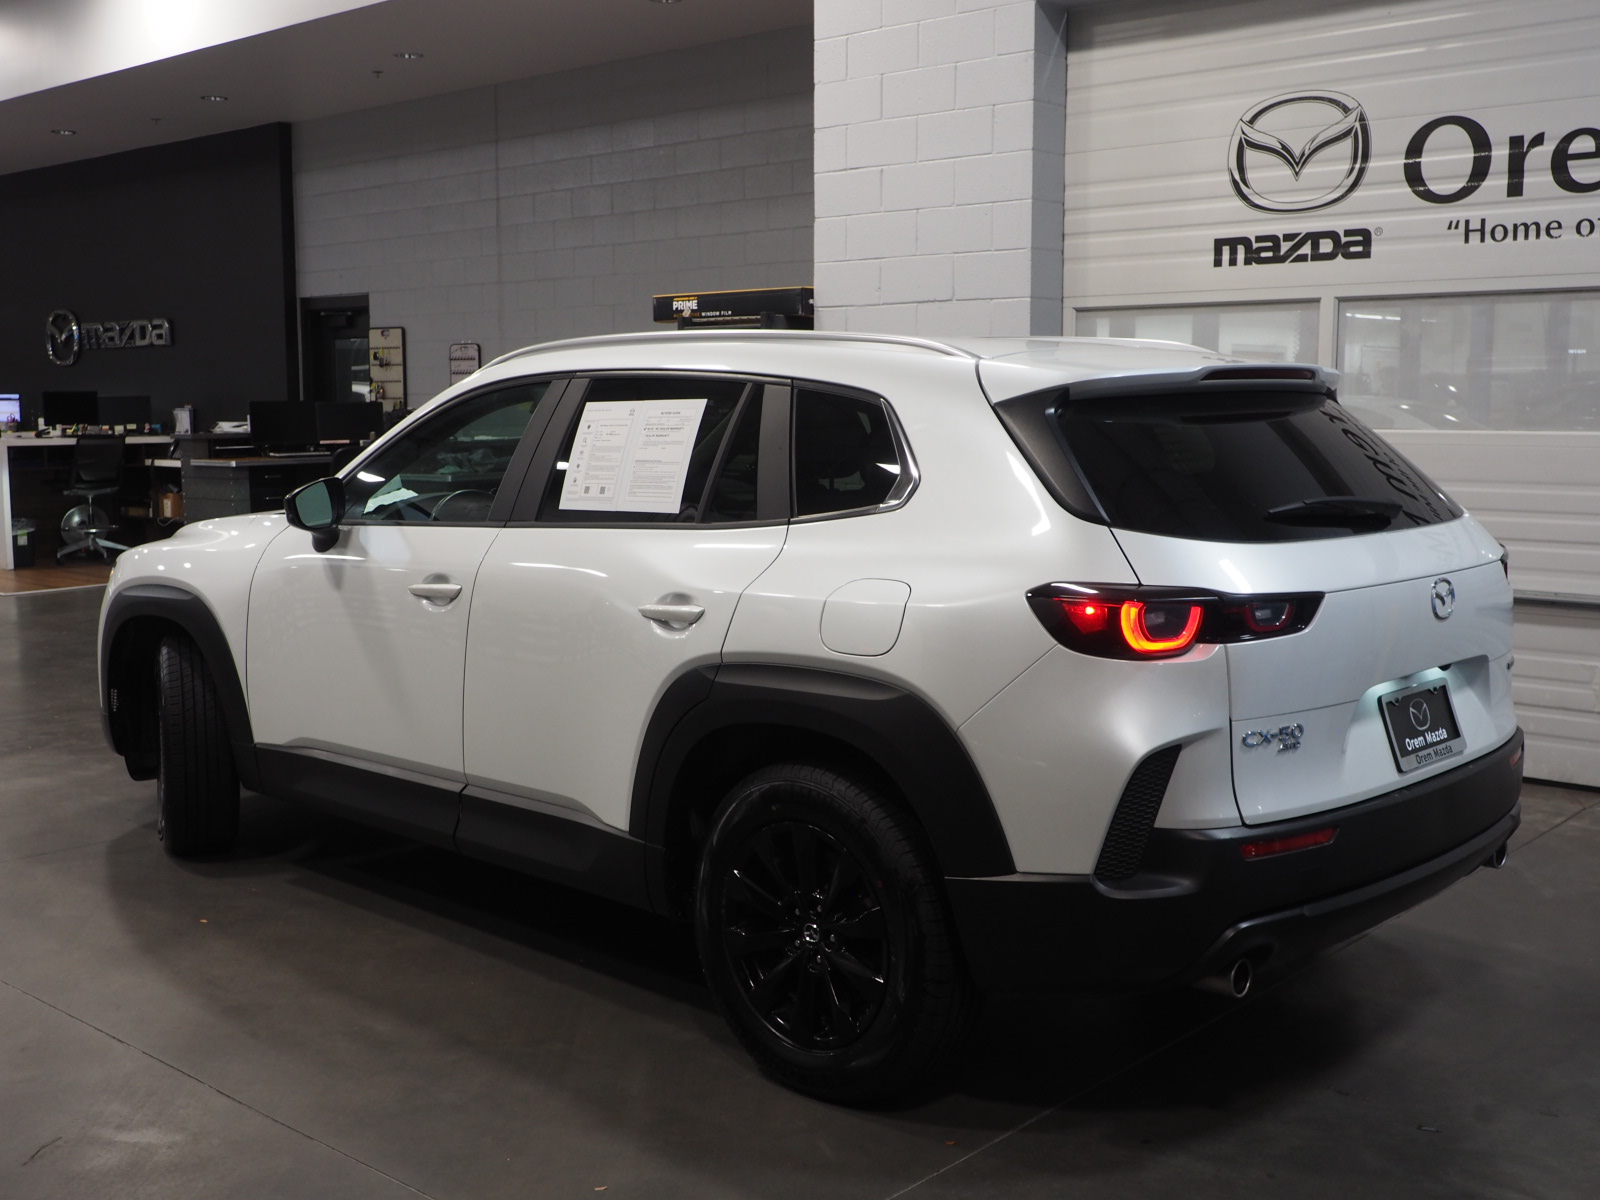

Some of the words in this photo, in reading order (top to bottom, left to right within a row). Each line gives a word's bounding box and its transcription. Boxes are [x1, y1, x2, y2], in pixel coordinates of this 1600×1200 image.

[1575, 217, 1600, 238] o
[672, 300, 698, 310] PRIME
[1242, 723, 1304, 747] CX-50
[1405, 735, 1426, 751] Orem
[1425, 727, 1448, 744] Mazda
[1415, 751, 1434, 764] Orem
[1433, 744, 1453, 758] Mazda
